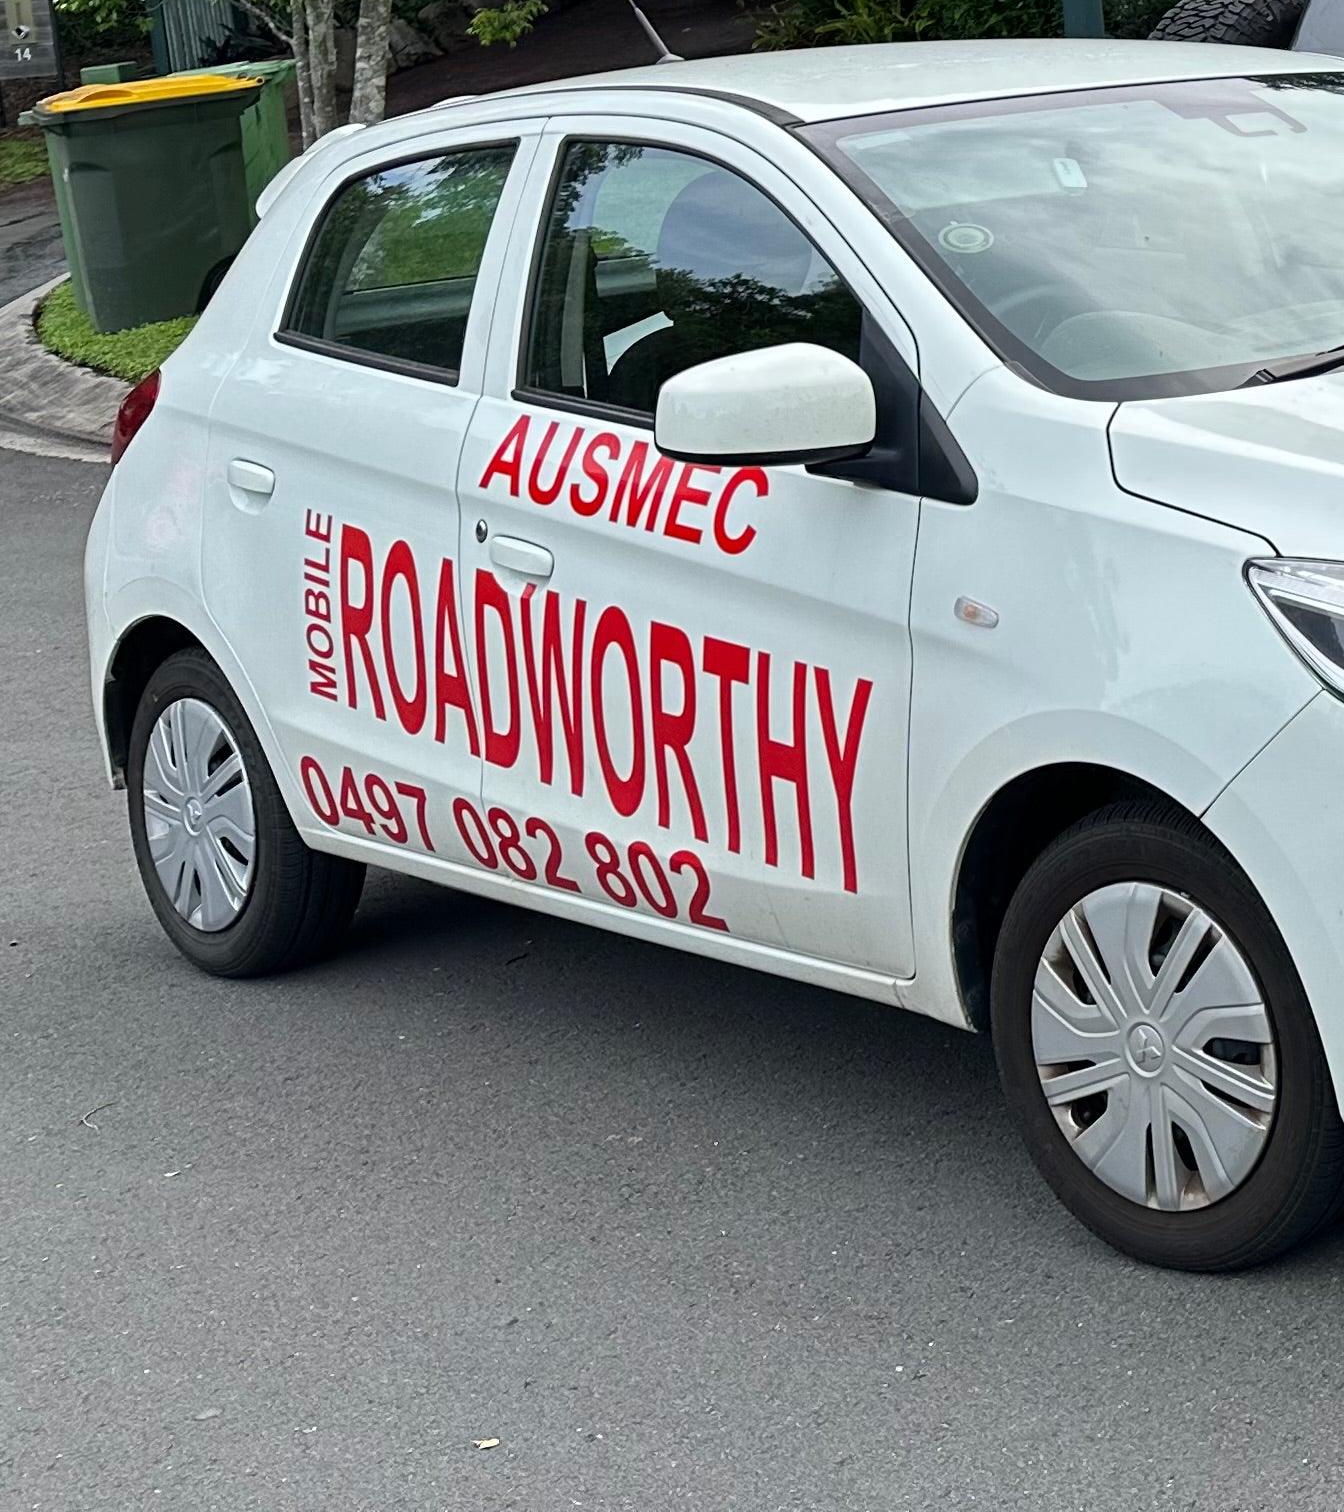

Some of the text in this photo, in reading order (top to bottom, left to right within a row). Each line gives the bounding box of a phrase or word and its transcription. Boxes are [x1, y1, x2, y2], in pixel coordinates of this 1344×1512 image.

[14, 47, 32, 62] 14
[479, 414, 770, 556] AUSMEC
[303, 507, 339, 702] MOBILE
[339, 523, 874, 895] ROADWORTHY
[299, 755, 731, 932] 0497 082 802
